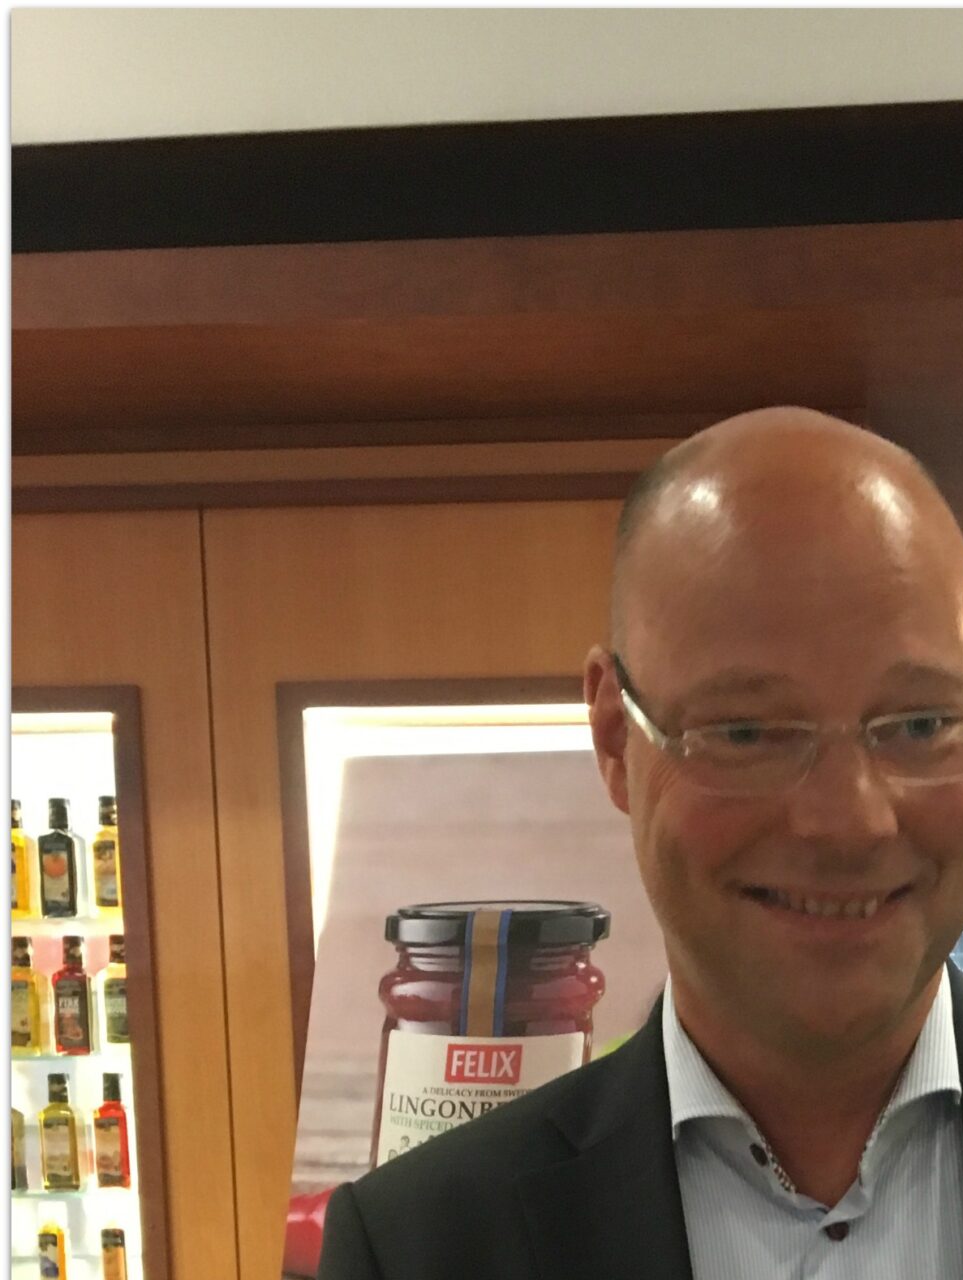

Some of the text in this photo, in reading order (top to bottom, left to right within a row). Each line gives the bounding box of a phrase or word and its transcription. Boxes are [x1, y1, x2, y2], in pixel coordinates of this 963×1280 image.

[450, 1050, 516, 1078] FELIX
[422, 1087, 428, 1095] A
[430, 1087, 472, 1097] DELICACY
[475, 1088, 500, 1097] FROM
[389, 1093, 508, 1119] LINGONB
[390, 1116, 454, 1132] WITH SPICED
